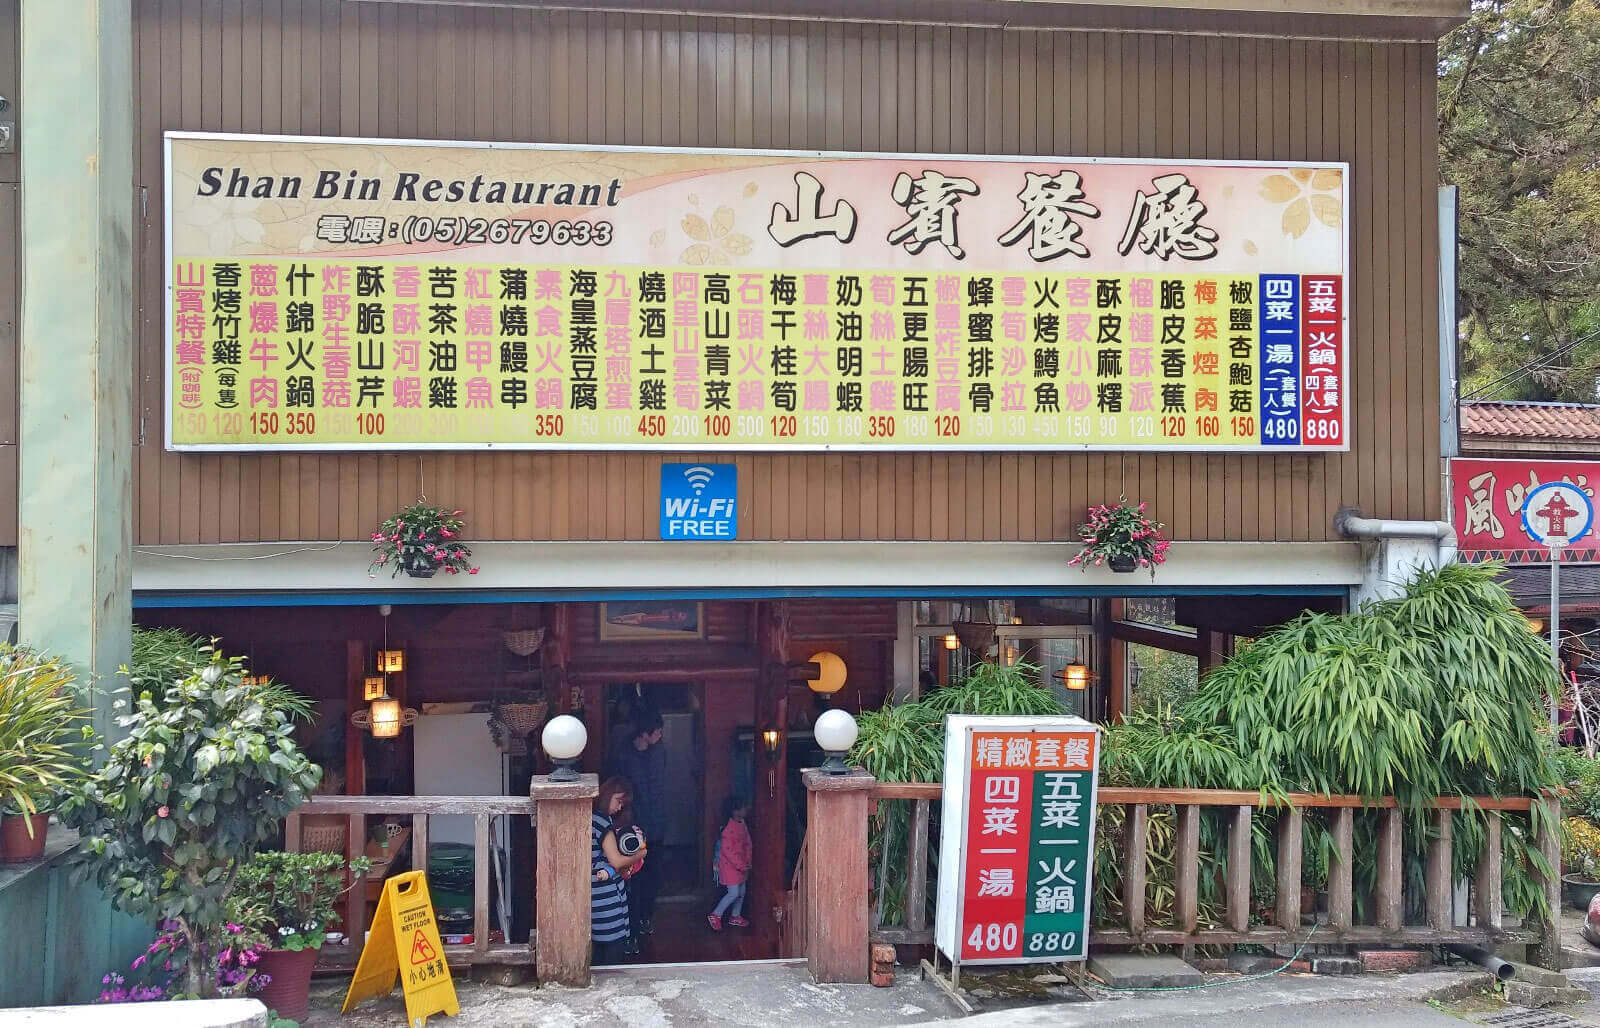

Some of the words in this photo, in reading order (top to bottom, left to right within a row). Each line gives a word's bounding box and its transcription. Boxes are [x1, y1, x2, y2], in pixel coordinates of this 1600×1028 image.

[197, 167, 302, 199] Shan
[312, 170, 381, 201] Bin
[392, 172, 622, 207] Restaurant
[767, 170, 1219, 262] 山賓餐廳
[286, 264, 315, 408] 什錦火鍋
[322, 264, 351, 408] 炸野生香菇
[356, 266, 385, 408] 酥脆山芹
[392, 266, 422, 409] 香酥河蝦
[428, 267, 458, 409] 苦茶油雞
[464, 267, 494, 409] 紅燒甲魚
[499, 268, 528, 409] 蒲燒鰻串
[534, 269, 564, 410] 素食火鍋
[569, 269, 598, 411] 海皇蒸豆腐
[604, 269, 632, 410] 九層塔煎蛋
[638, 271, 667, 411] 燒酒土雞
[704, 273, 731, 411] 高山青菜
[737, 273, 765, 412] 石頭火鍋
[770, 274, 797, 412] 梅干桂筍
[836, 275, 863, 412] 奶油明蝦
[869, 275, 896, 412] 筍絲土雞
[902, 277, 929, 412] 五更腸旺
[968, 276, 994, 413] 蜂蜜排骨
[1033, 277, 1060, 413] 火烤鱒魚
[1066, 277, 1092, 412] 客家小炒
[1096, 279, 1122, 413] 酥皮麻糬
[1160, 280, 1186, 414] 脆皮香蕉
[1229, 280, 1253, 413] 椒鹽杏鮑菇
[213, 413, 242, 435] 120
[250, 412, 279, 435] 150
[286, 412, 315, 435] 350
[356, 412, 385, 435] 100
[535, 414, 563, 436] 350
[605, 415, 632, 436] 100
[638, 415, 666, 437] 450
[672, 415, 699, 437] 200
[704, 415, 731, 437] 100
[737, 415, 764, 437] 500
[770, 415, 797, 437] 120
[803, 415, 829, 437] 150
[837, 416, 862, 437] 180
[869, 416, 895, 437] 350
[903, 416, 928, 437] 180
[934, 416, 960, 437] 120
[1066, 416, 1091, 437] 150
[1099, 416, 1118, 437] 90
[1129, 416, 1154, 437] 120
[1160, 416, 1186, 437] 120
[1195, 416, 1219, 437] 160
[1230, 416, 1254, 437] 150
[1264, 418, 1297, 438] 480
[1306, 419, 1339, 439] 880
[665, 498, 735, 518] Wi-Fi
[669, 519, 730, 536] FREE
[976, 736, 1090, 768] 精緻套餐
[977, 776, 1020, 897] 四菜一湯
[1034, 773, 1082, 914] 五菜一火鍋
[401, 923, 413, 933] WET
[413, 918, 431, 929] FLOOR
[403, 911, 426, 923] CAUTION
[967, 923, 1017, 952] 480
[1029, 931, 1076, 951] 880
[410, 959, 444, 985] 小心地滑
